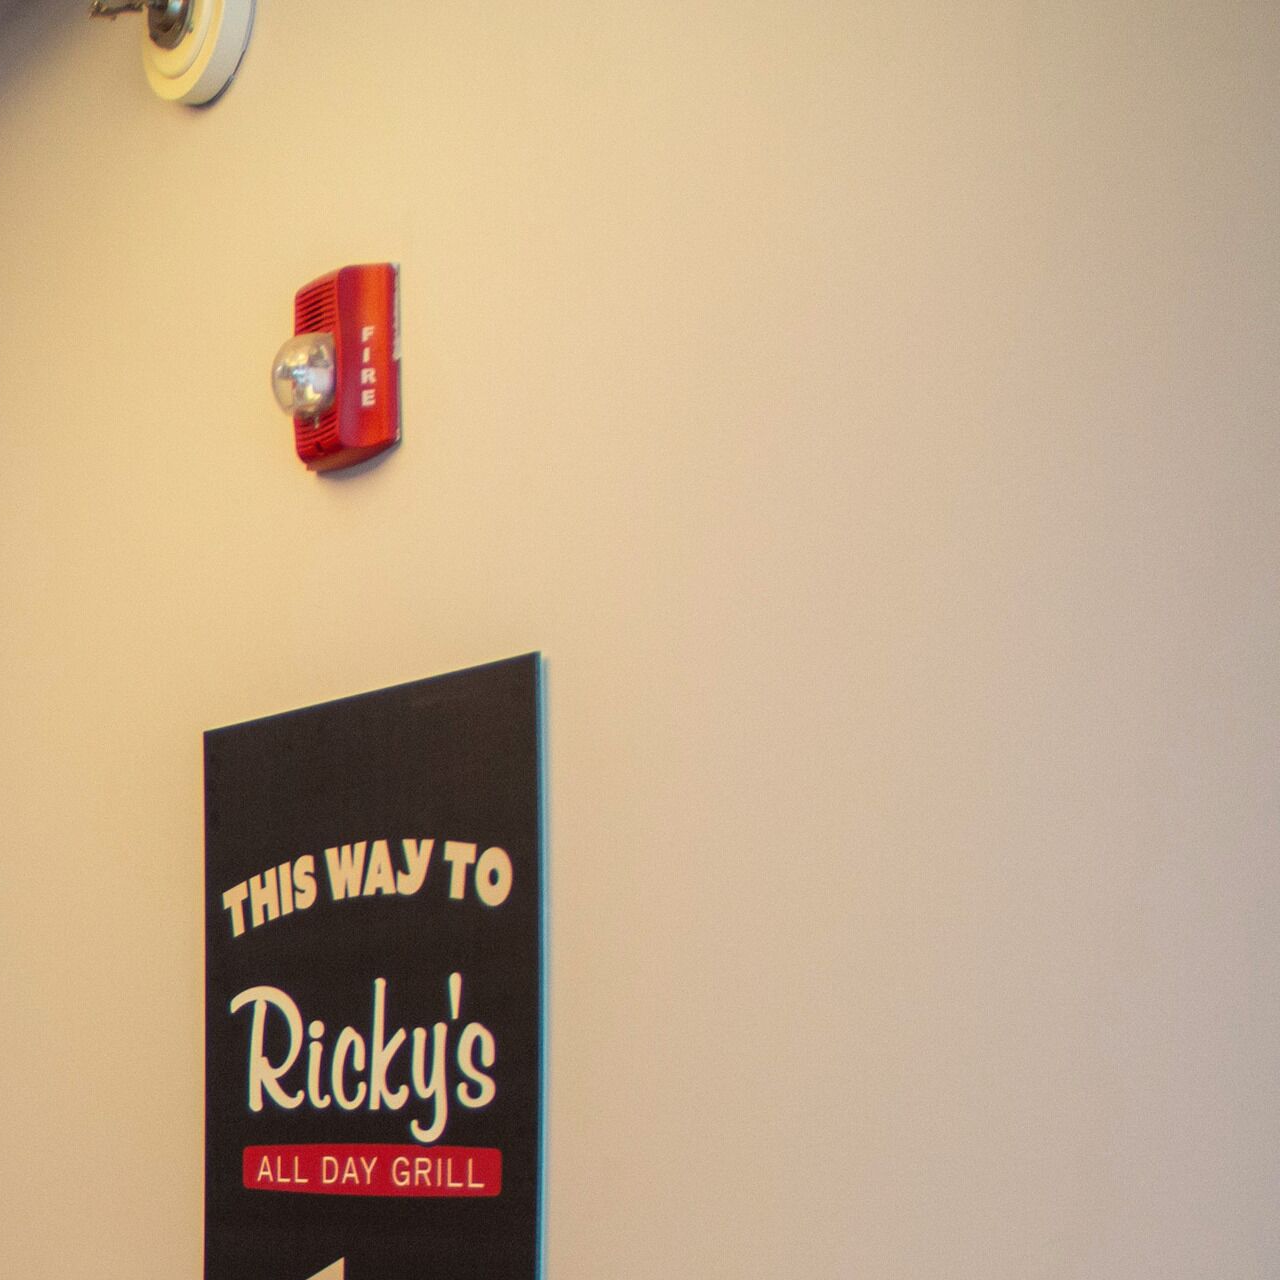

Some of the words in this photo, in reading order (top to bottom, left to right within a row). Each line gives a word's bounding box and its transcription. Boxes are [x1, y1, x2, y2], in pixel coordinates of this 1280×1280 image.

[361, 325, 377, 407] FIRE
[222, 854, 318, 938] THIS
[324, 838, 435, 901] WAY
[443, 840, 513, 907] TO
[230, 971, 496, 1143] Ricky's
[256, 1155, 309, 1184] ALL
[321, 1156, 378, 1185] DAY
[392, 1157, 486, 1188] GRILL
